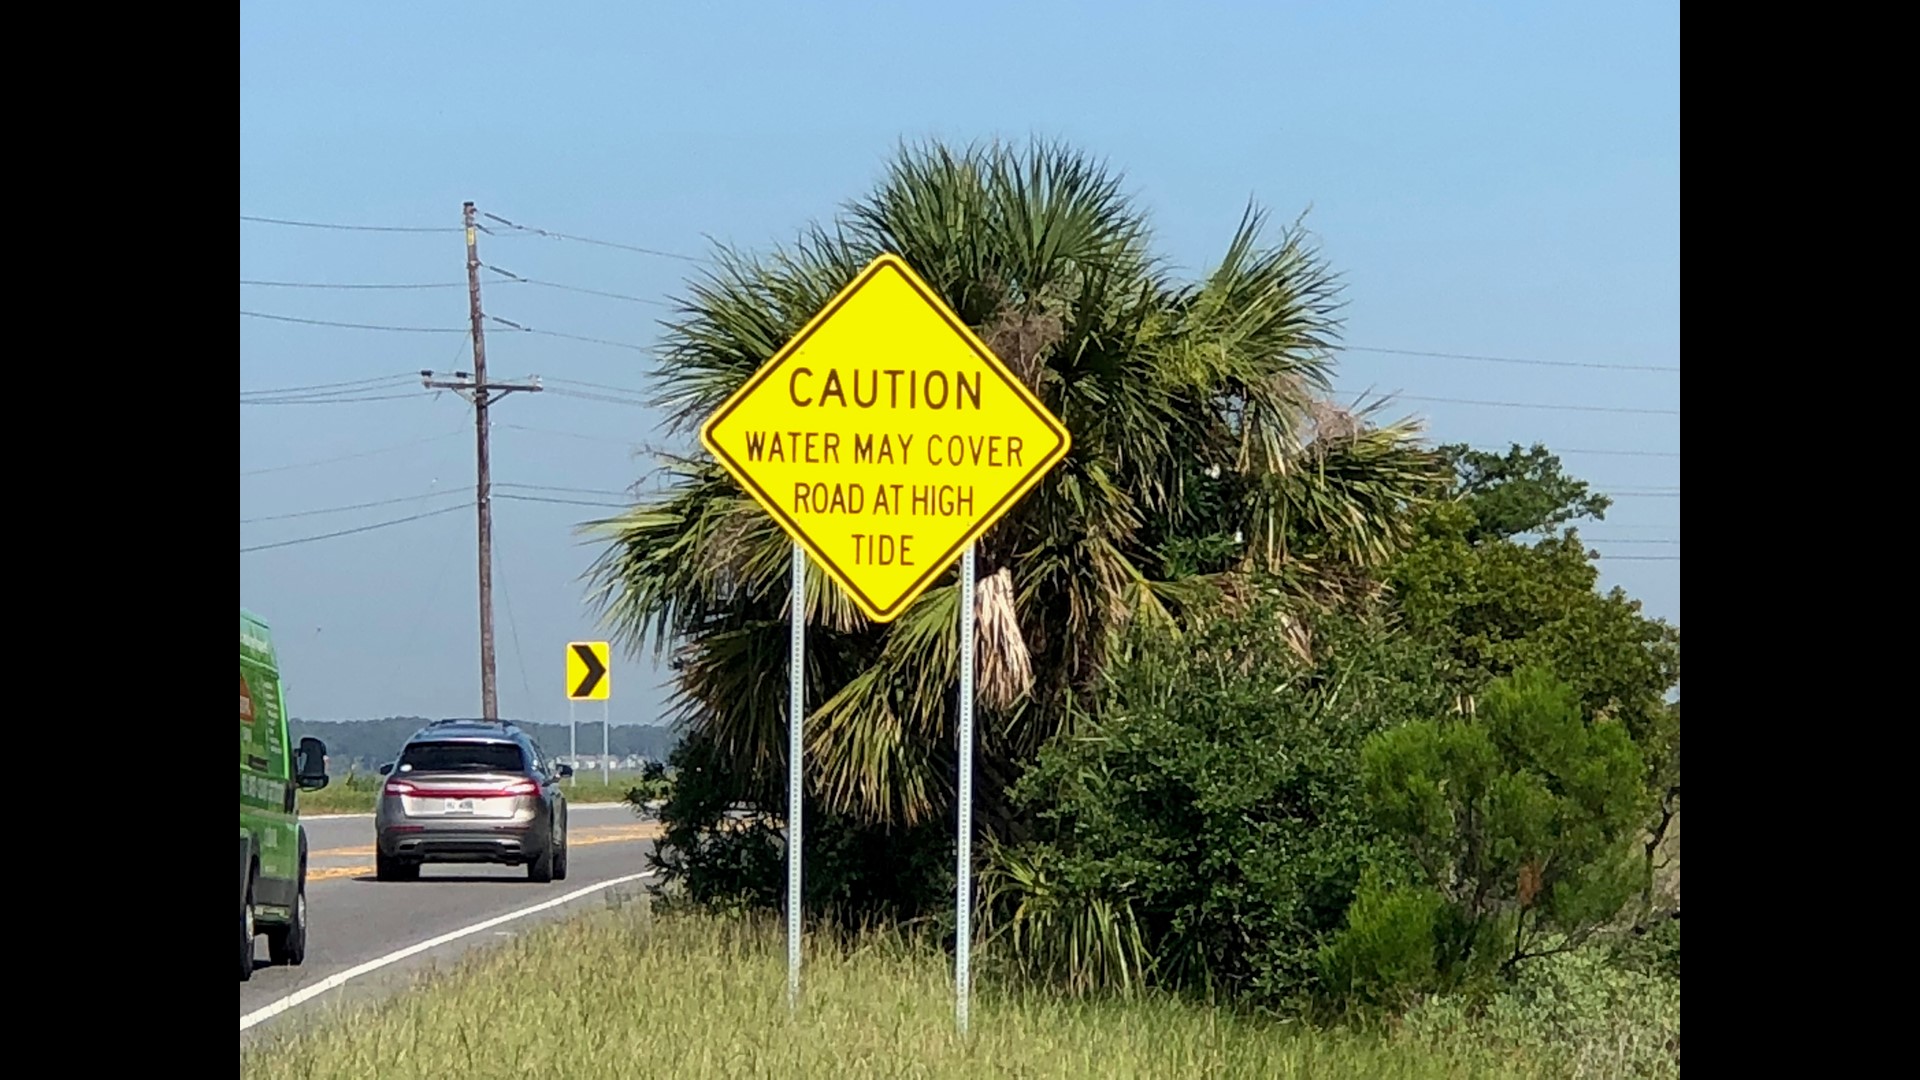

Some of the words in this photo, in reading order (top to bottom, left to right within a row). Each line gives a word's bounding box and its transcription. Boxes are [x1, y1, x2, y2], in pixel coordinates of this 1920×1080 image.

[789, 367, 982, 410] CAUTION
[745, 431, 840, 464] WATER
[854, 433, 914, 465] MAY
[927, 434, 1023, 467] COVER
[794, 483, 864, 515] ROAD
[873, 484, 904, 516] AT
[912, 485, 974, 517] HIGH
[851, 534, 915, 566] TIDE
